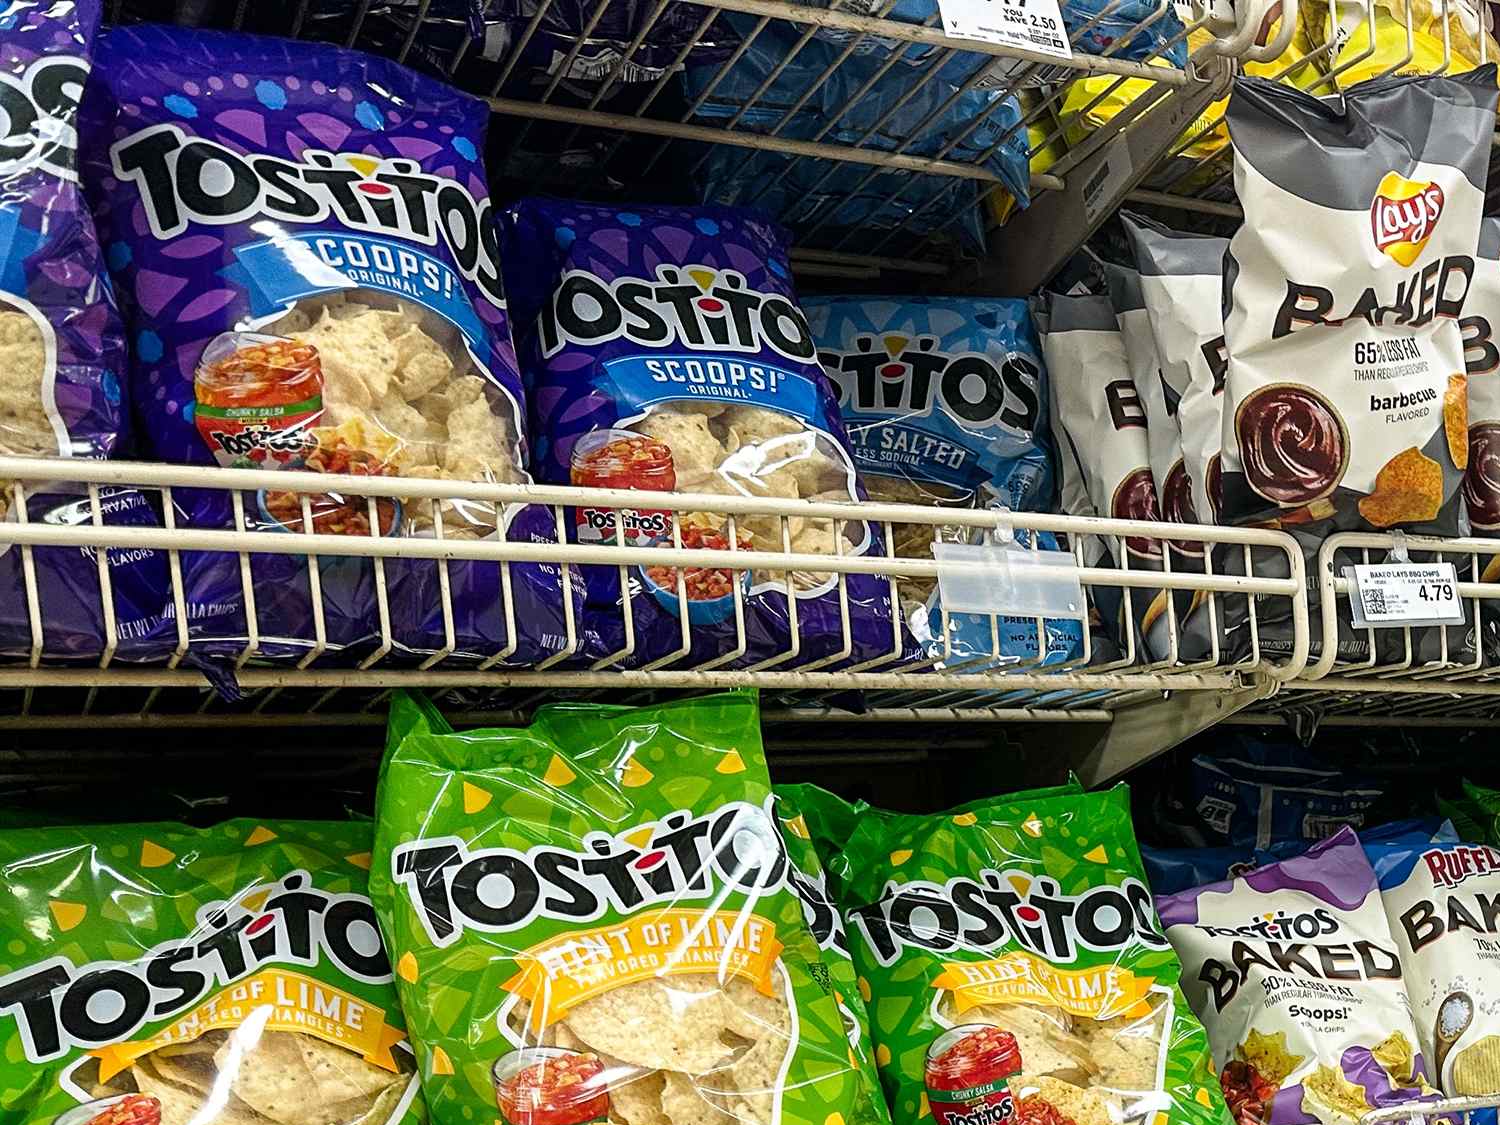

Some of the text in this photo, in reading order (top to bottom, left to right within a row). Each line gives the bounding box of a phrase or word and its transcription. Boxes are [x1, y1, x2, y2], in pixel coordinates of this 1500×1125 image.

[1003, 7, 1023, 17] YOU
[1004, 14, 1057, 30] SAVE 2.50
[1373, 187, 1444, 245] Lay's
[1355, 337, 1421, 364] 65% LESS FAT
[646, 360, 778, 391] SCOOPS!
[688, 384, 751, 399] ORIGINAL
[1370, 386, 1437, 411] barbecue
[879, 426, 965, 470] SALTED
[1419, 585, 1453, 601] 4.79
[851, 875, 1168, 962] TOSTITOS
[1195, 908, 1339, 940] TOSTITOS
[642, 920, 672, 946] OF
[684, 918, 763, 954] LIME
[1199, 940, 1402, 1014] BAKED
[278, 975, 364, 1031] LIME
[1289, 1005, 1348, 1021] Scoops!
